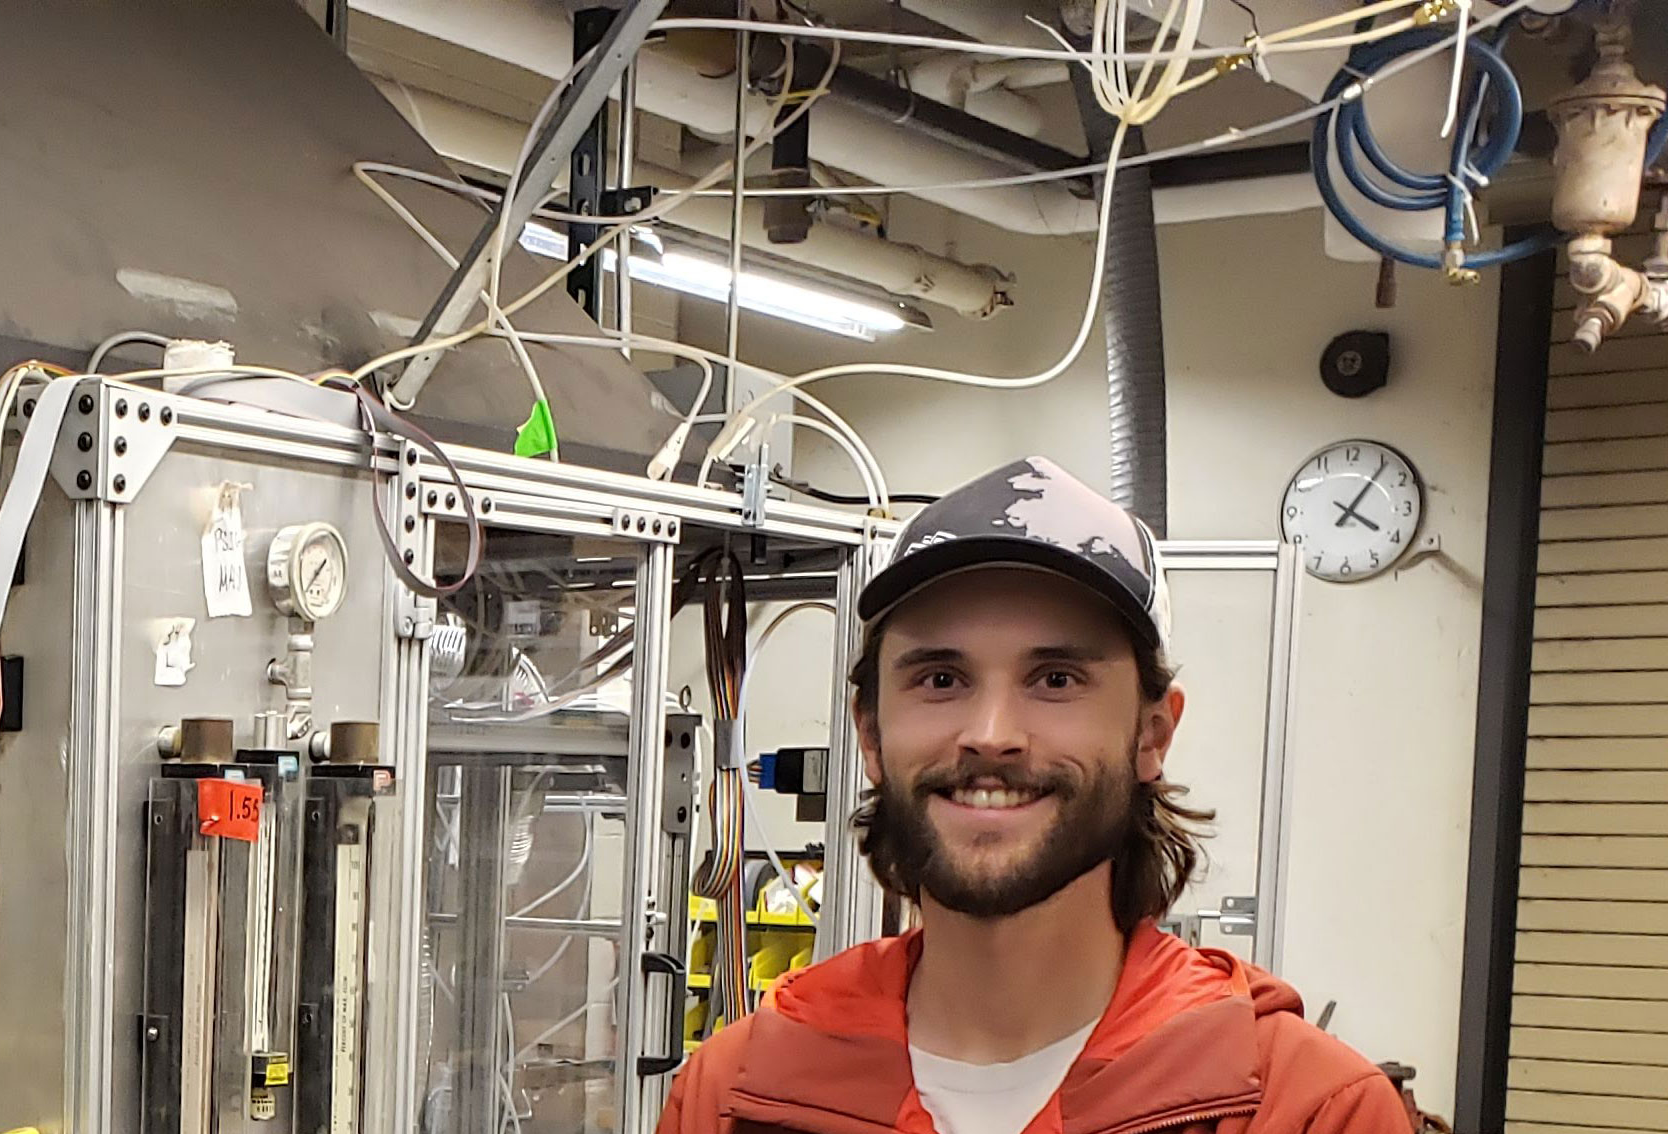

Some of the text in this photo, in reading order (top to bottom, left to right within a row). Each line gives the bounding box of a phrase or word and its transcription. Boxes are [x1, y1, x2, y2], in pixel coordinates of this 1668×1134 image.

[1345, 447, 1361, 462] 12
[1317, 455, 1330, 474] 11
[1397, 471, 1408, 488] 2
[1286, 505, 1298, 521] 9
[1401, 500, 1412, 518] 3
[1389, 528, 1401, 544] 4
[1313, 556, 1323, 571] 7
[1340, 555, 1352, 576] 6
[1368, 549, 1380, 569] 5
